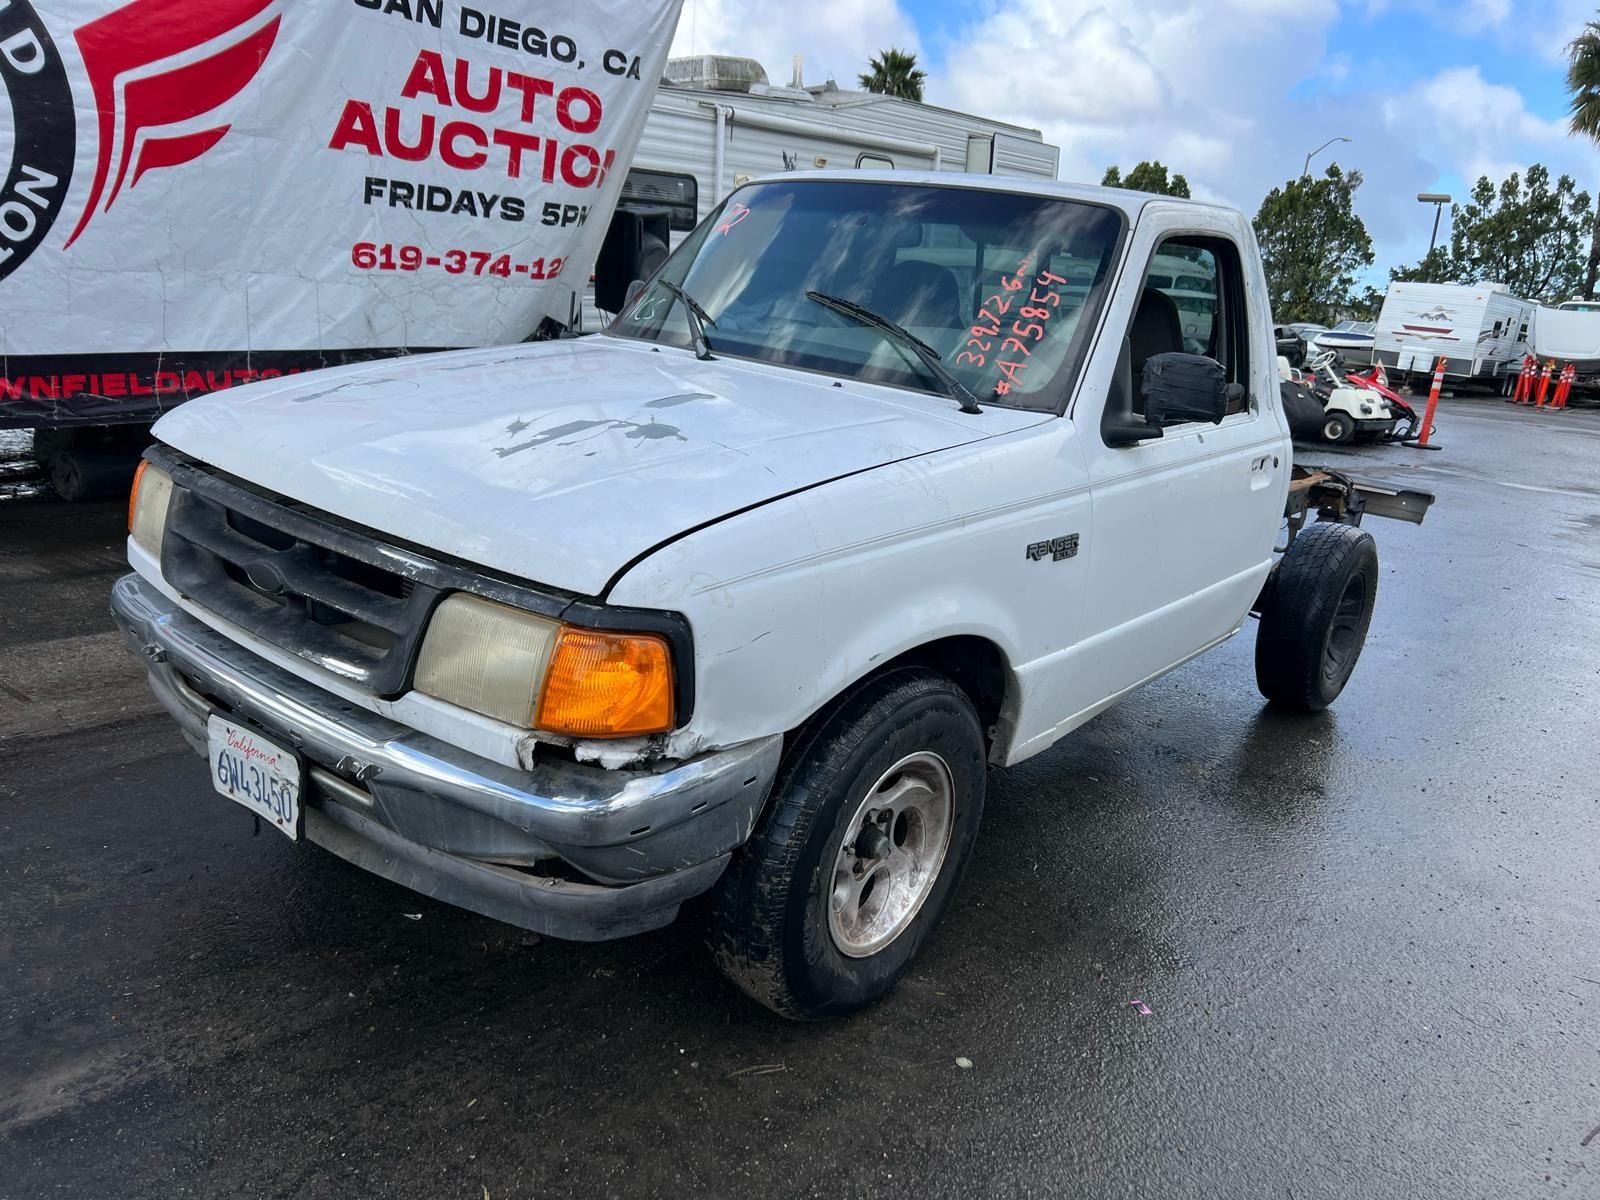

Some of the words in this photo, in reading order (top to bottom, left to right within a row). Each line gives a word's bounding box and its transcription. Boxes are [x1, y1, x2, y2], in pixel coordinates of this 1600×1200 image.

[459, 6, 585, 70] DIEGO,
[602, 48, 642, 81] CA
[400, 49, 603, 134] AUTO
[363, 176, 525, 223] FRIDAYS
[351, 242, 569, 281] 619-374-12
[0, 367, 313, 399] WNFIELDAUT
[1026, 533, 1079, 561] RANGER
[228, 729, 281, 772] California
[218, 749, 292, 823] 6W43450
